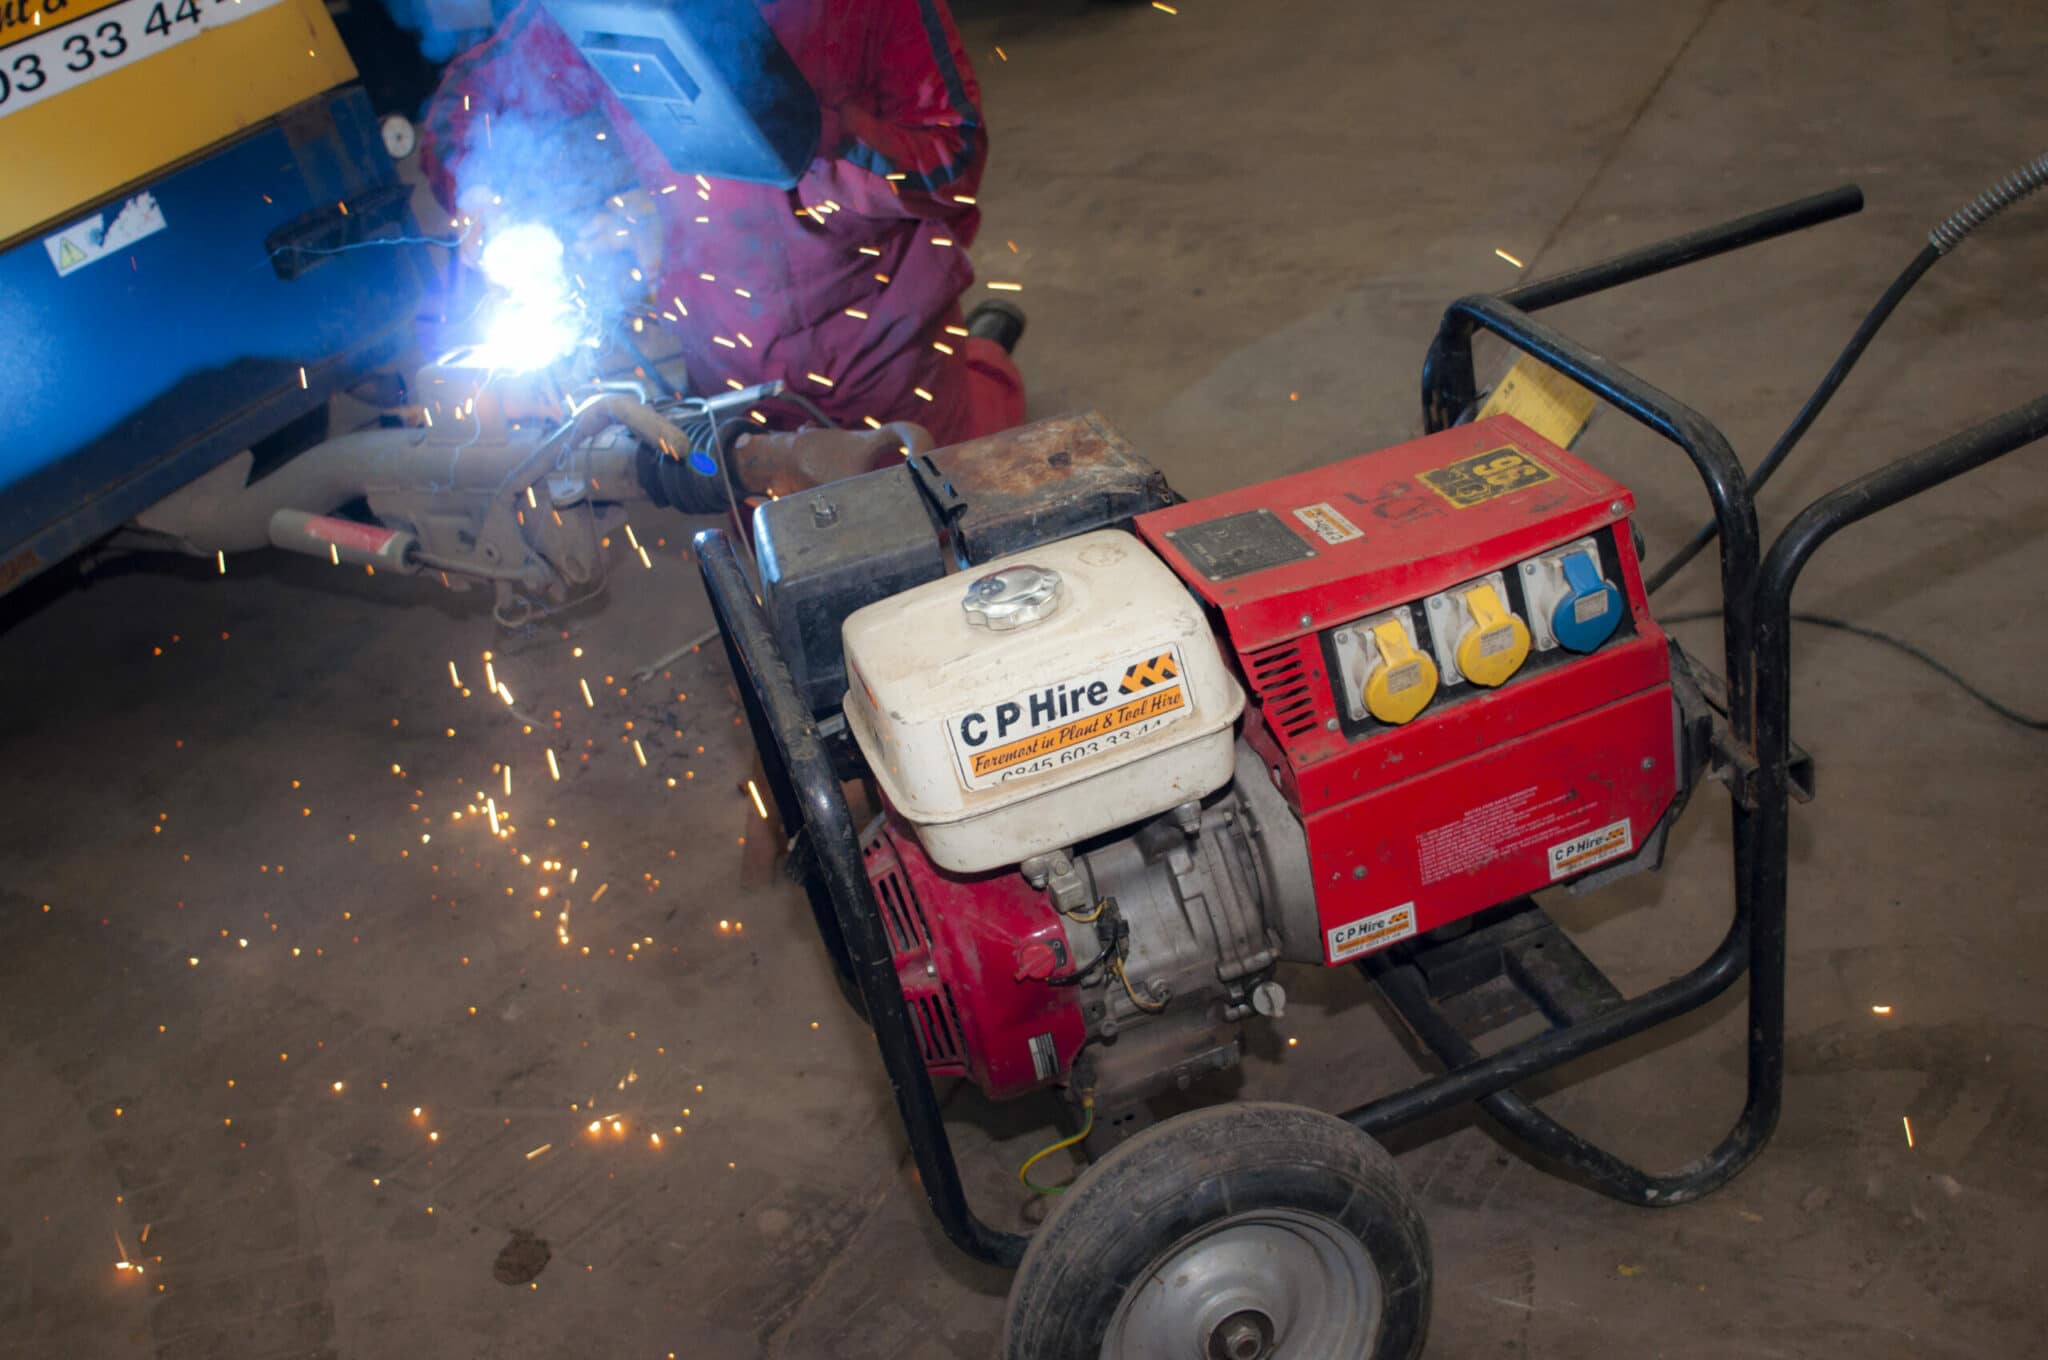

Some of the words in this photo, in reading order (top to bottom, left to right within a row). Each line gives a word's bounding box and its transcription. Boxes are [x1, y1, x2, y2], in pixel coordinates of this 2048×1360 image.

[62, 21, 128, 72] 33
[145, 0, 202, 35] 44
[960, 712, 988, 747] C
[996, 702, 1021, 738] P
[1029, 681, 1108, 727] Hire
[975, 741, 1038, 772] Foremost
[1041, 736, 1055, 749] in
[1059, 718, 1099, 744] Plant
[1103, 713, 1113, 729] &
[1117, 699, 1148, 724] Tool
[1150, 693, 1181, 713] Hire
[1566, 845, 1575, 857] P
[1577, 836, 1603, 853] Hire
[1335, 932, 1345, 943] C
[1347, 927, 1356, 940] P
[1359, 919, 1385, 936] Hire
